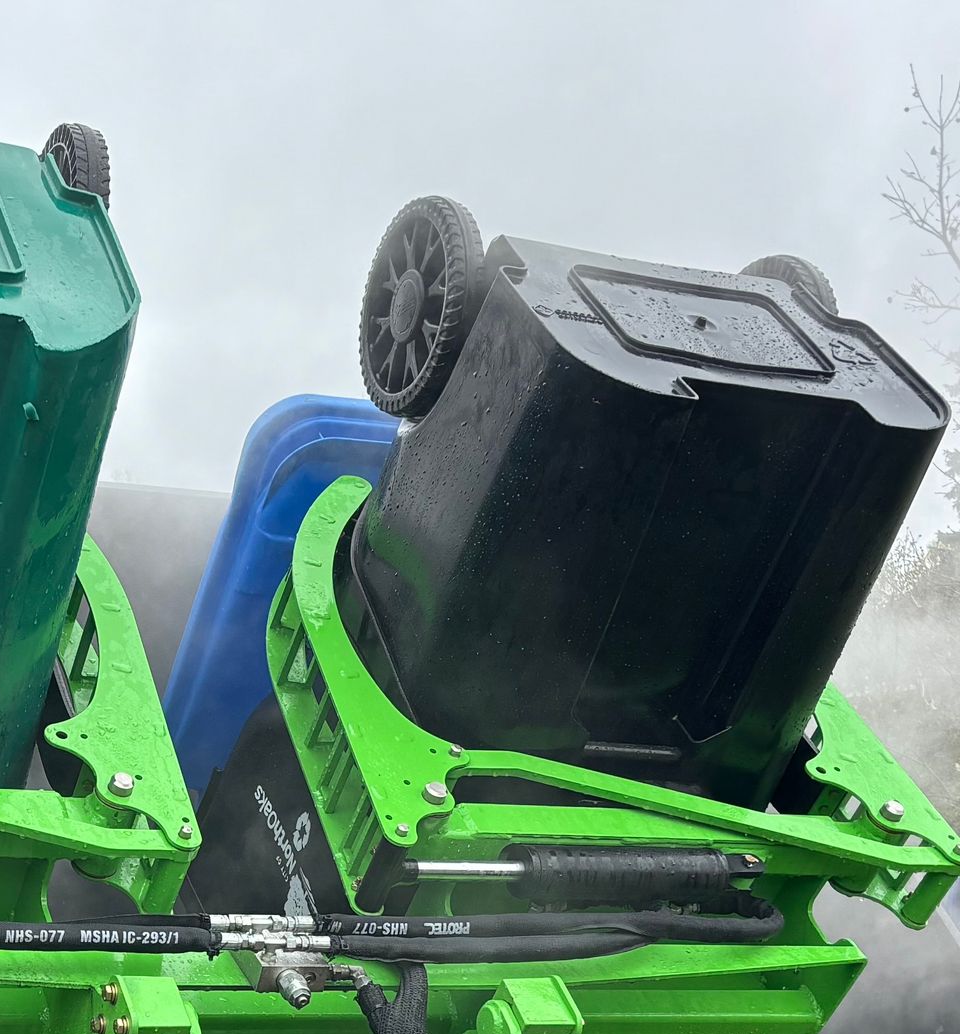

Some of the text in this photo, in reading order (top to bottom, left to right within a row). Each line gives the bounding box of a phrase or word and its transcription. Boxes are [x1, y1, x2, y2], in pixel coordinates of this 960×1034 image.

[352, 922, 408, 935] NHS-077
[424, 922, 470, 935] PROTEC
[5, 930, 65, 944] NHS-077
[80, 930, 119, 944] MSHA
[122, 930, 179, 945] IC-293/1
